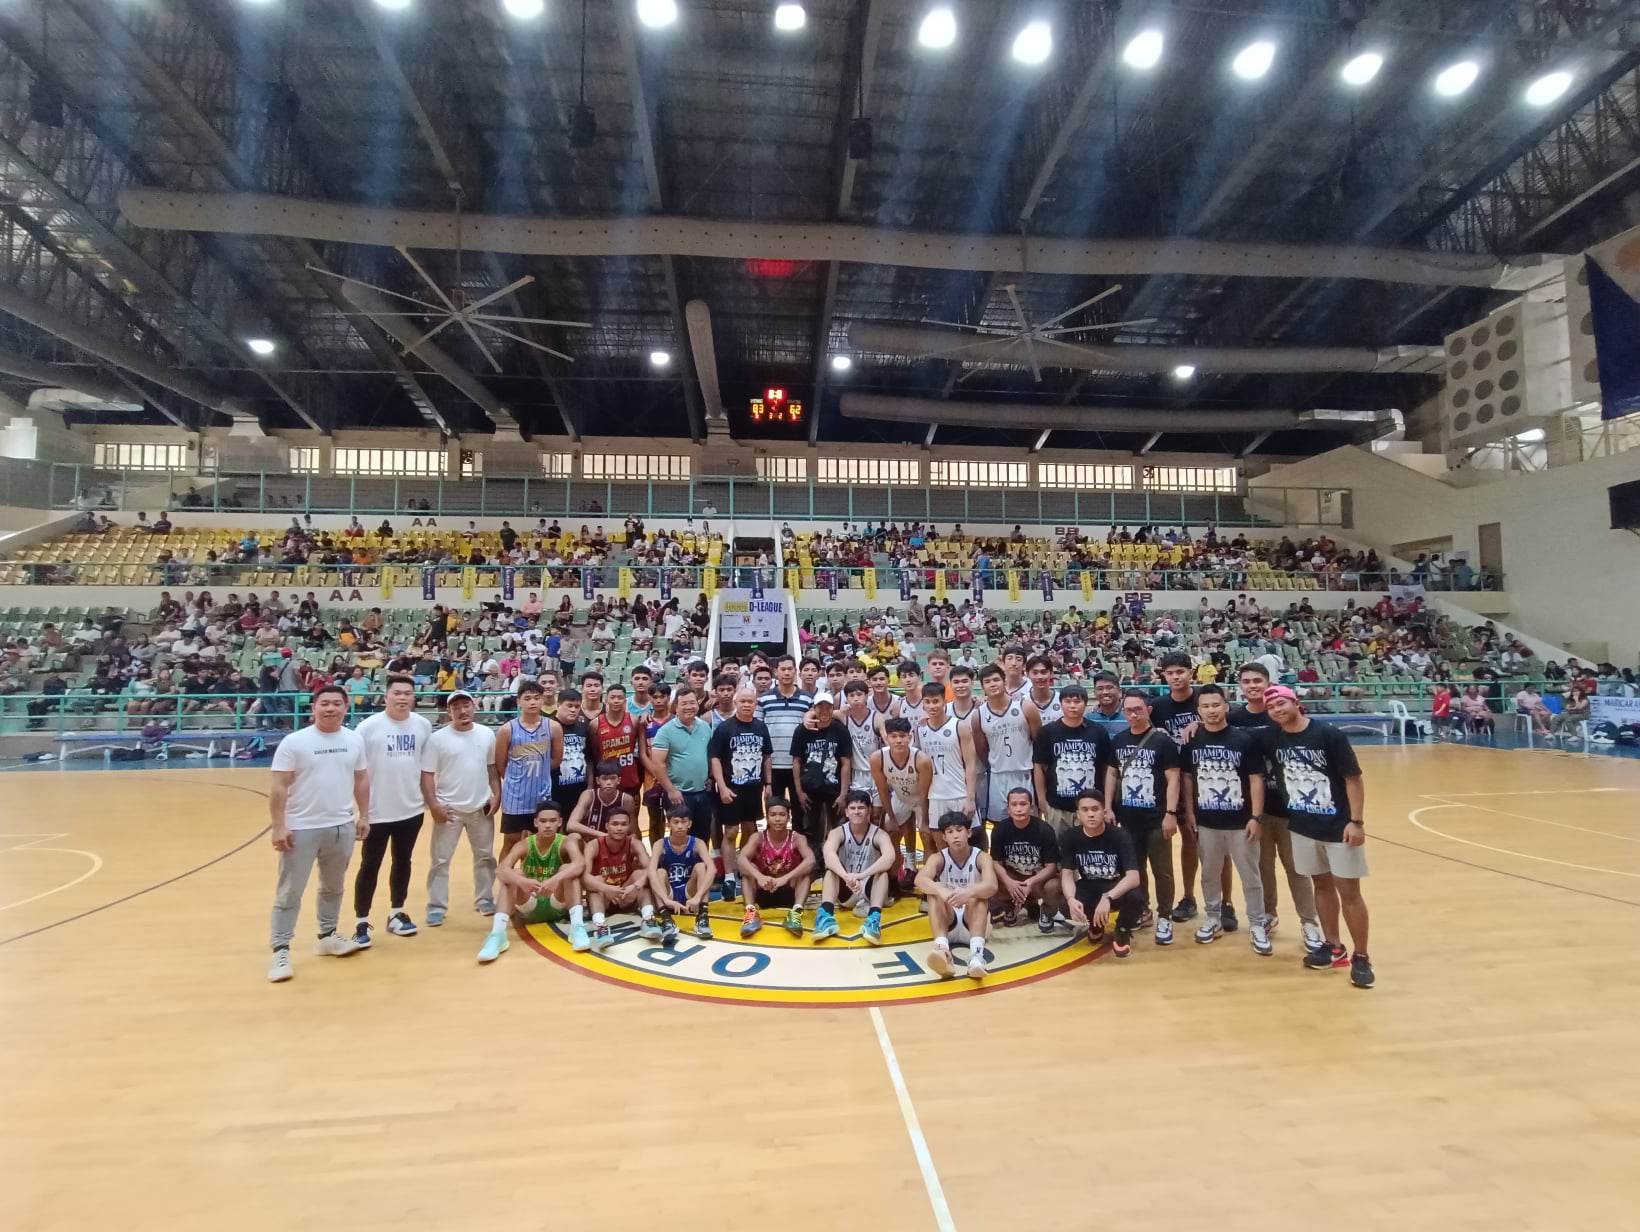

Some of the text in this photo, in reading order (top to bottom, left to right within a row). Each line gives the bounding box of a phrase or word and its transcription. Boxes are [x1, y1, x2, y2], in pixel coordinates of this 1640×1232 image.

[749, 601, 783, 613] D-LEAGUE
[396, 735, 415, 751] NBA
[1003, 736, 1013, 758] 5
[619, 753, 634, 767] 69
[526, 760, 540, 777] 71
